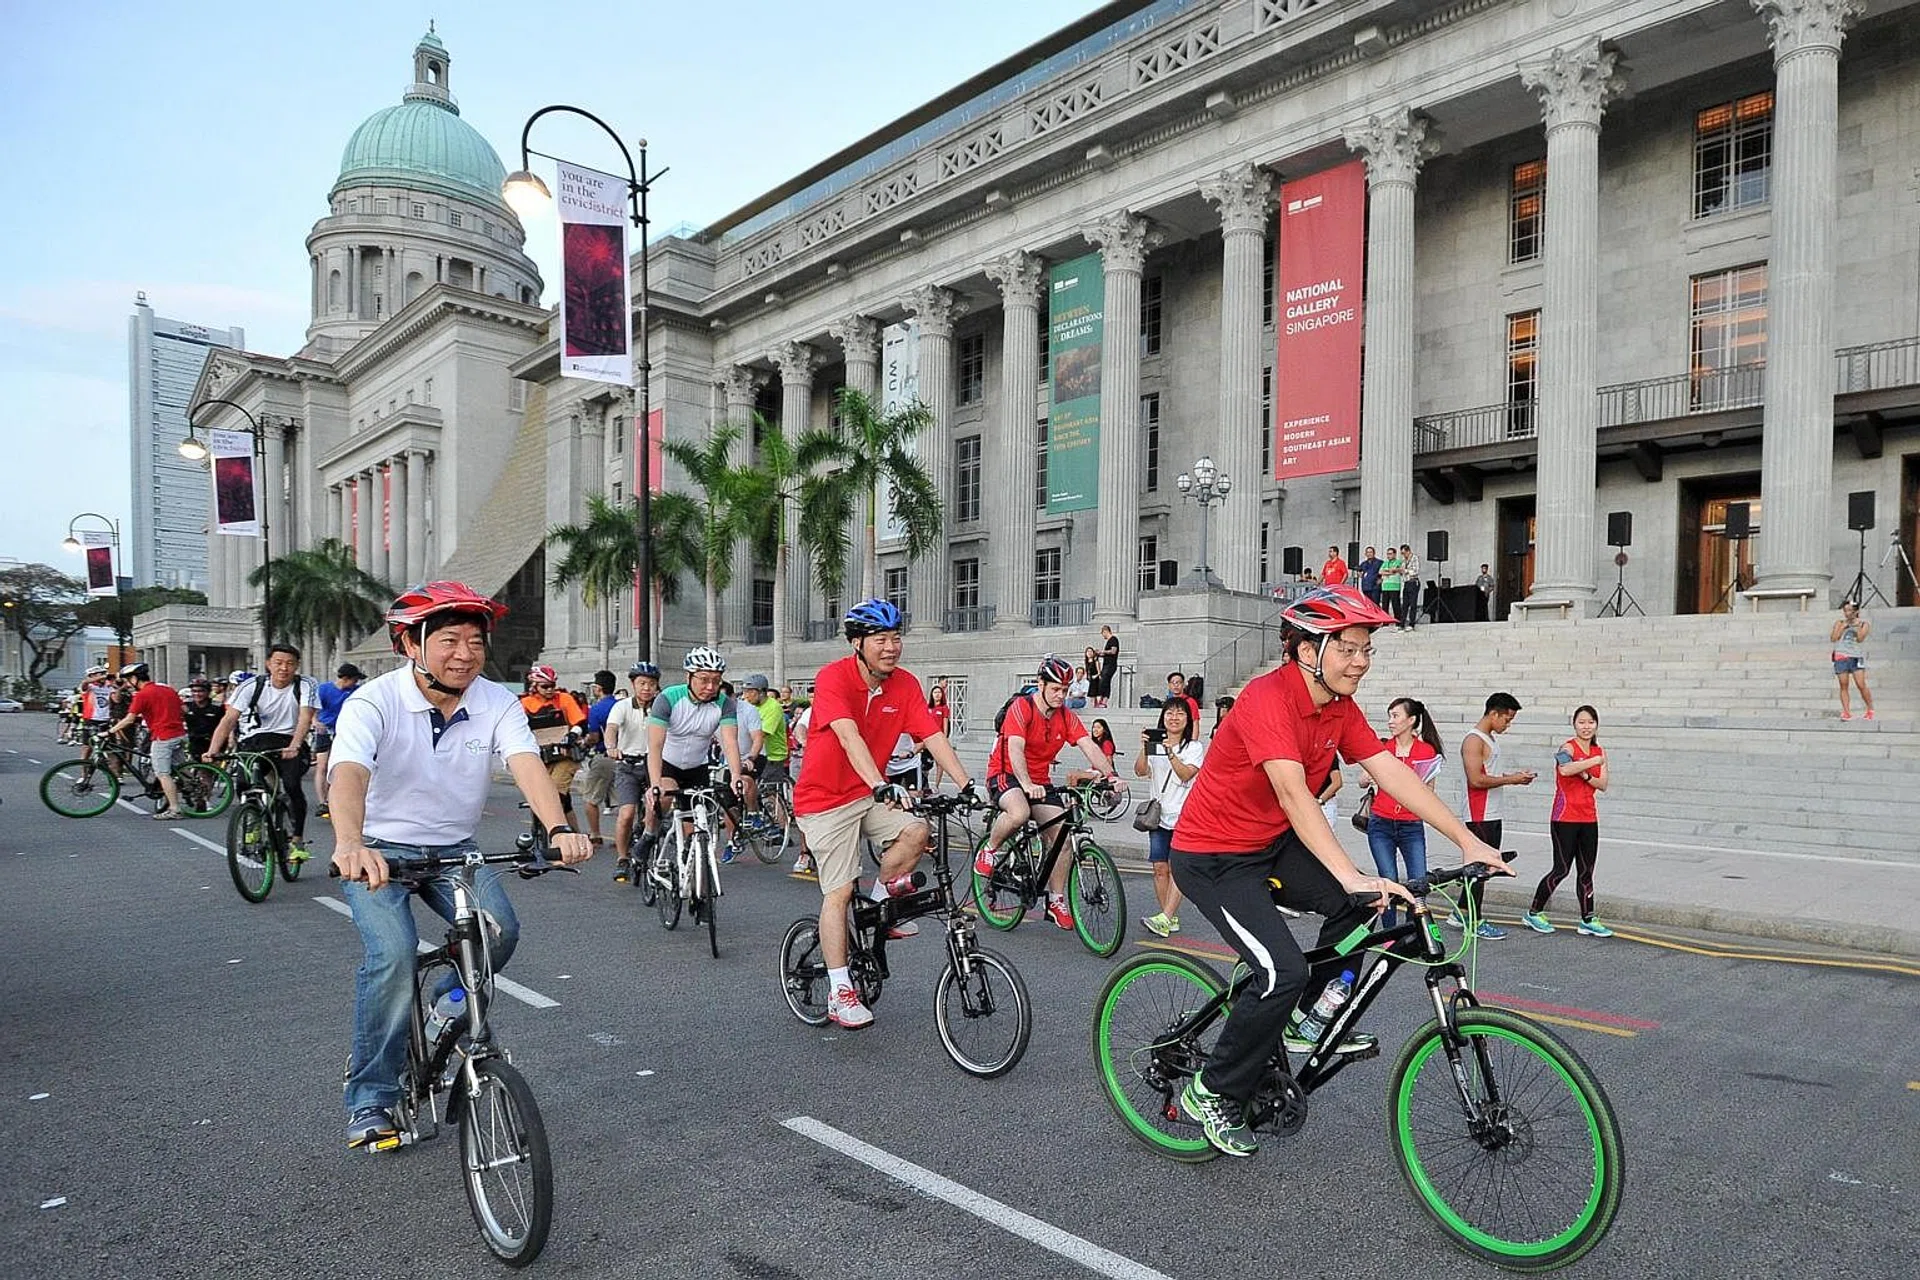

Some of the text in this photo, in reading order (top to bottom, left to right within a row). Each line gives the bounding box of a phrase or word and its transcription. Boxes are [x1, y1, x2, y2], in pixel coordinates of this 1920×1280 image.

[561, 170, 604, 189] you are
[562, 182, 596, 199] in the
[561, 194, 624, 218] civicdistrict
[1286, 278, 1344, 303] NATIONAL
[1286, 296, 1339, 319] GALLERY
[1053, 312, 1103, 333] DECLARATIONS
[1286, 308, 1355, 335] SINGAPORE
[1284, 415, 1330, 429] EXPERIENCE
[1283, 430, 1315, 441] MODERN
[1283, 436, 1352, 454] SOUTHEAST ASIAN
[1282, 457, 1297, 466] ART
